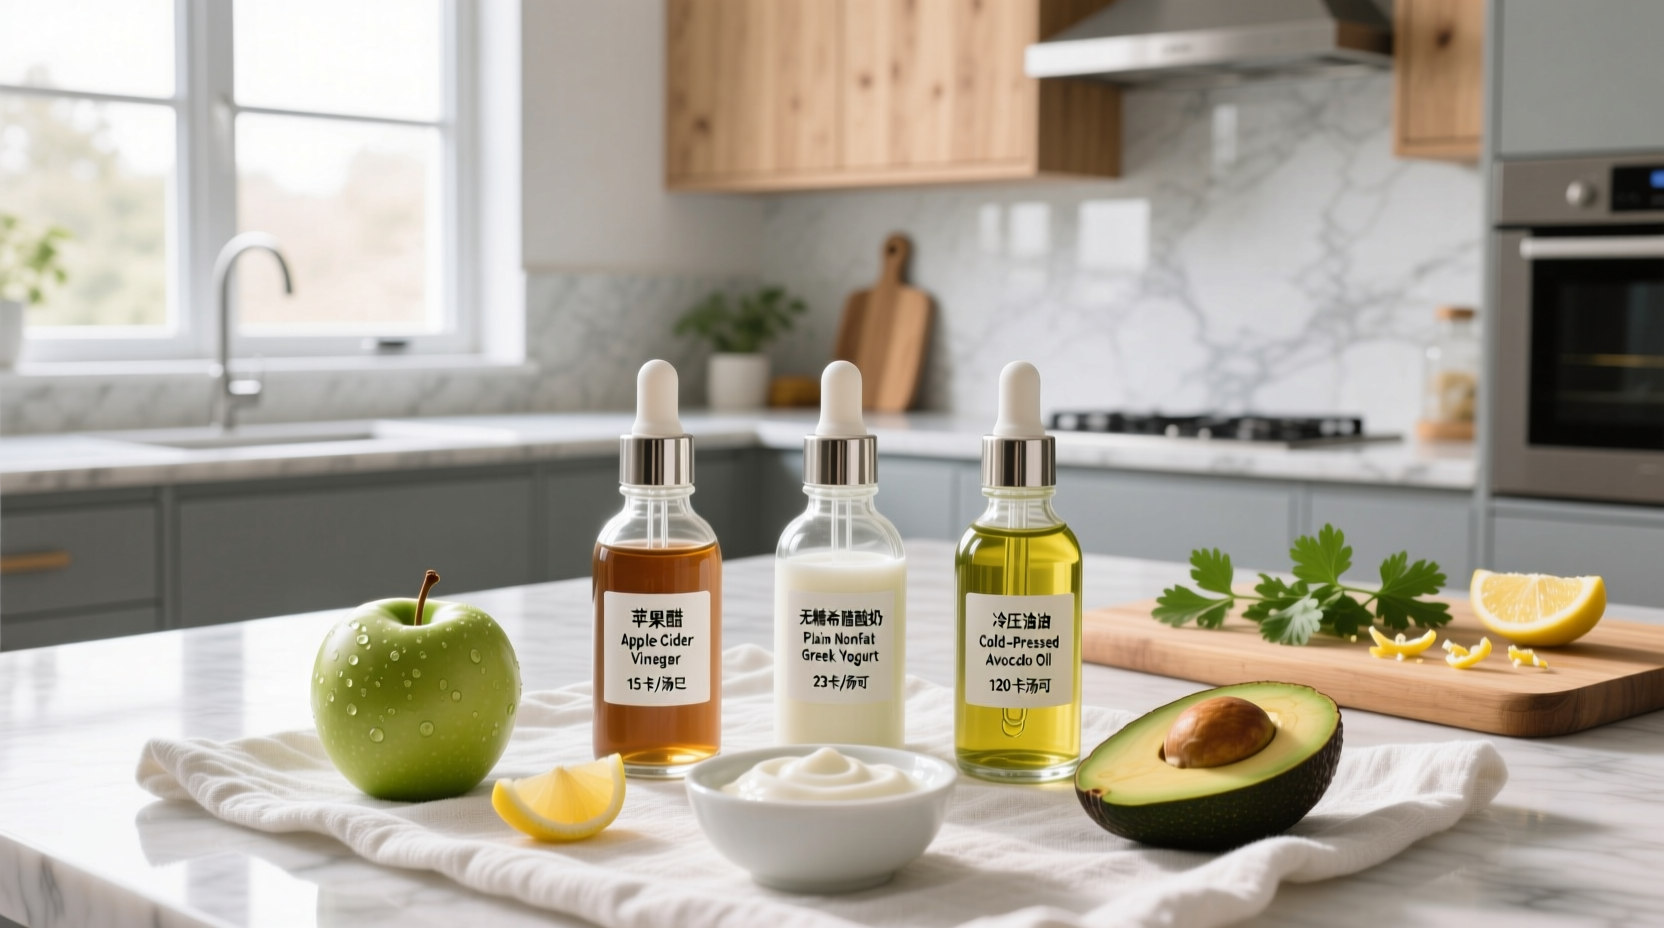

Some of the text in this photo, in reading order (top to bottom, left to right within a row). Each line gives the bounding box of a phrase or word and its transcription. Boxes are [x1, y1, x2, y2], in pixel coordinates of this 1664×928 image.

[631, 608, 683, 629] 苹果醋
[621, 633, 694, 651] Apple Cider
[804, 632, 875, 645] Plain Nonfat
[980, 634, 1059, 648] Cold-Pressed
[802, 649, 879, 666] Greek Yogurt
